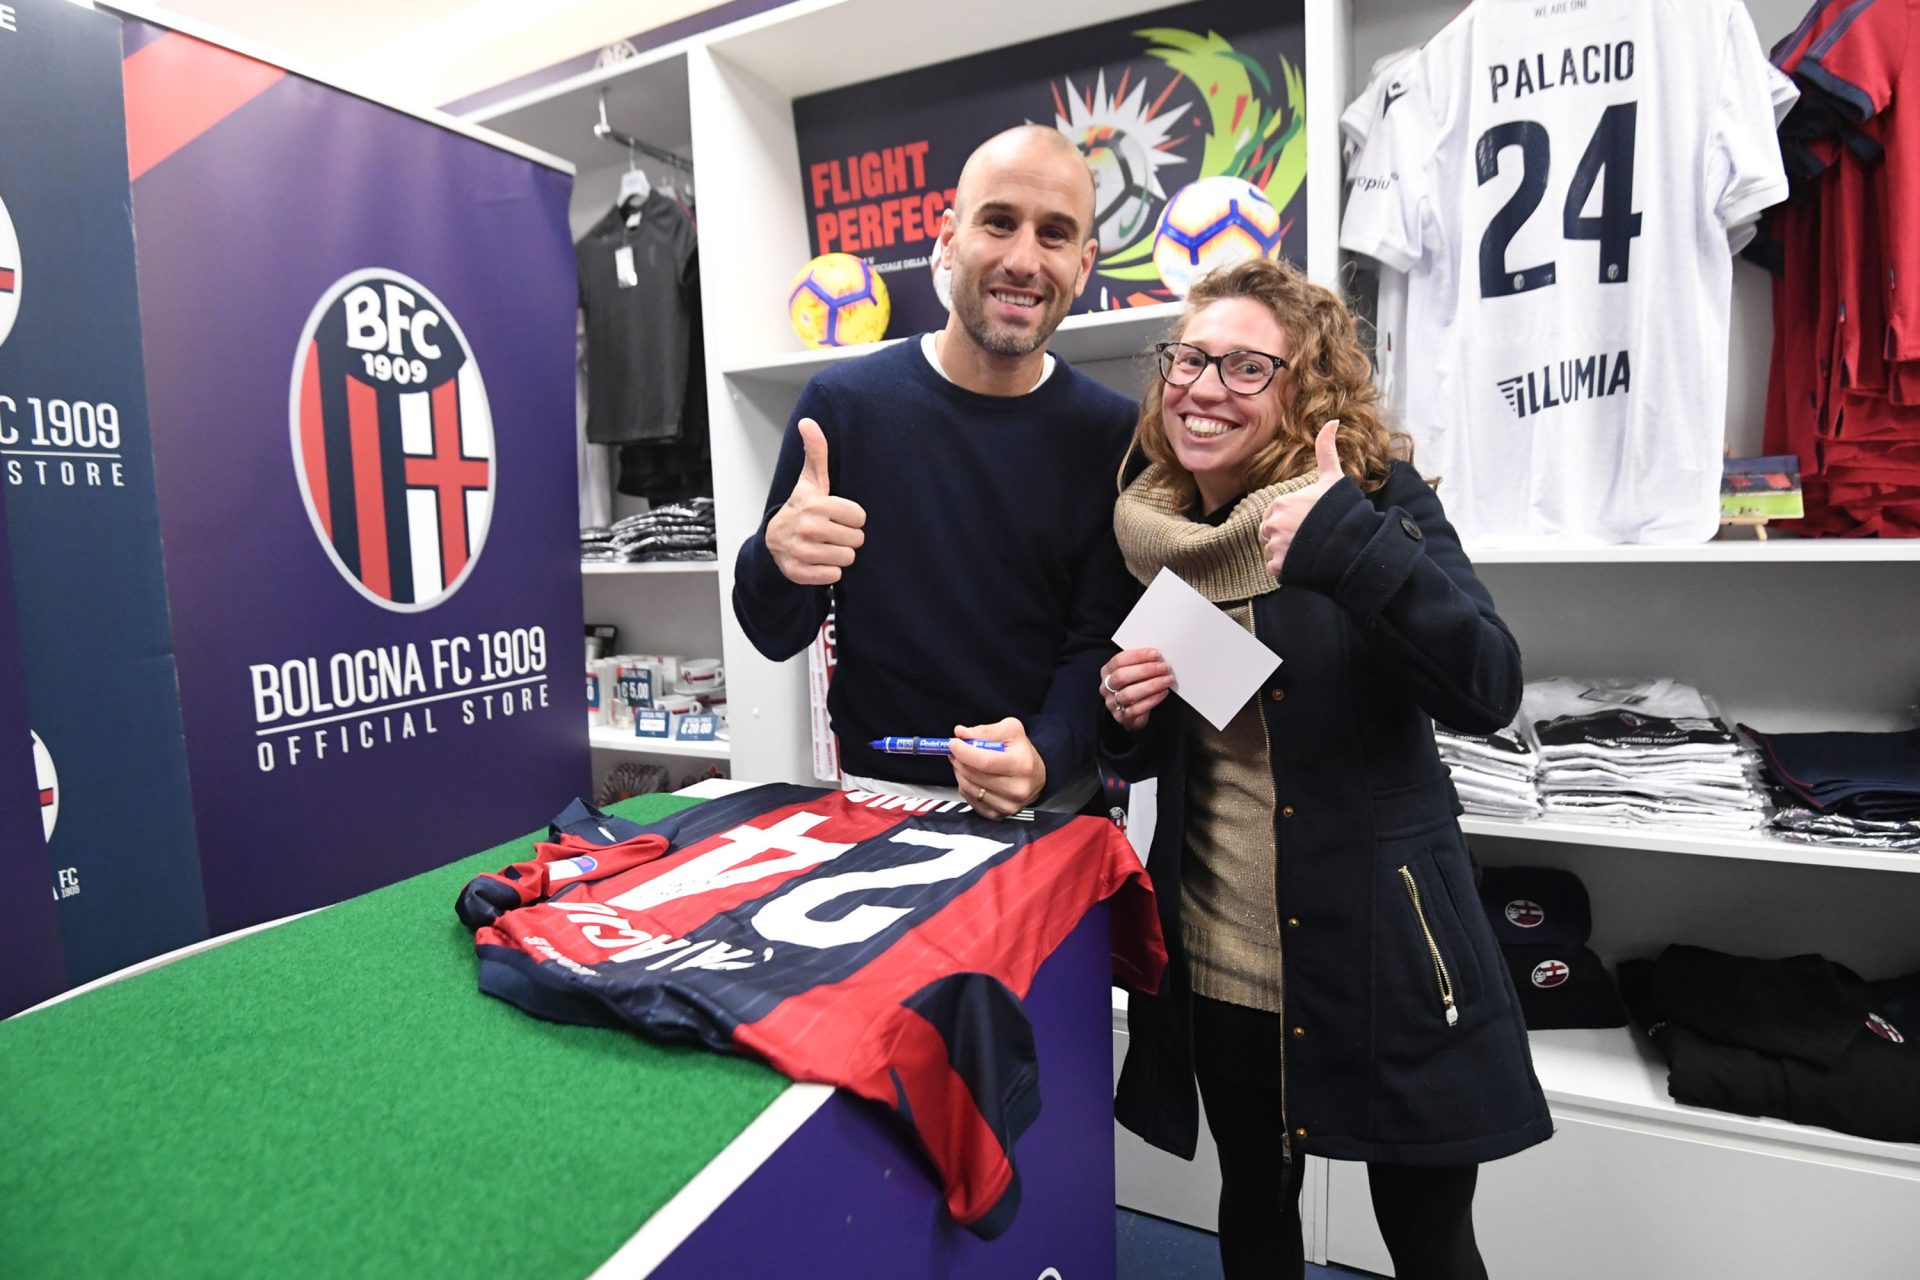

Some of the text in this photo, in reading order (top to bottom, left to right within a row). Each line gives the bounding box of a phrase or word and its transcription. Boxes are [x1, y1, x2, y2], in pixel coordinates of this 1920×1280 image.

[1551, 3, 1566, 15] ARE
[1489, 40, 1634, 103] PALACIO
[810, 140, 929, 209] FLIGHT
[1476, 101, 1642, 298] 24
[343, 283, 442, 360] BFC
[361, 352, 428, 385] 1909
[1497, 350, 1630, 418] ILLUMIA
[27, 397, 121, 449] 1909
[7, 460, 125, 487] STORE
[249, 626, 547, 723] BOLOGNA FC 1909
[257, 684, 549, 772] OFFICIAL STORE
[1654, 736, 1689, 744] PRODUCT
[58, 867, 79, 889] FC
